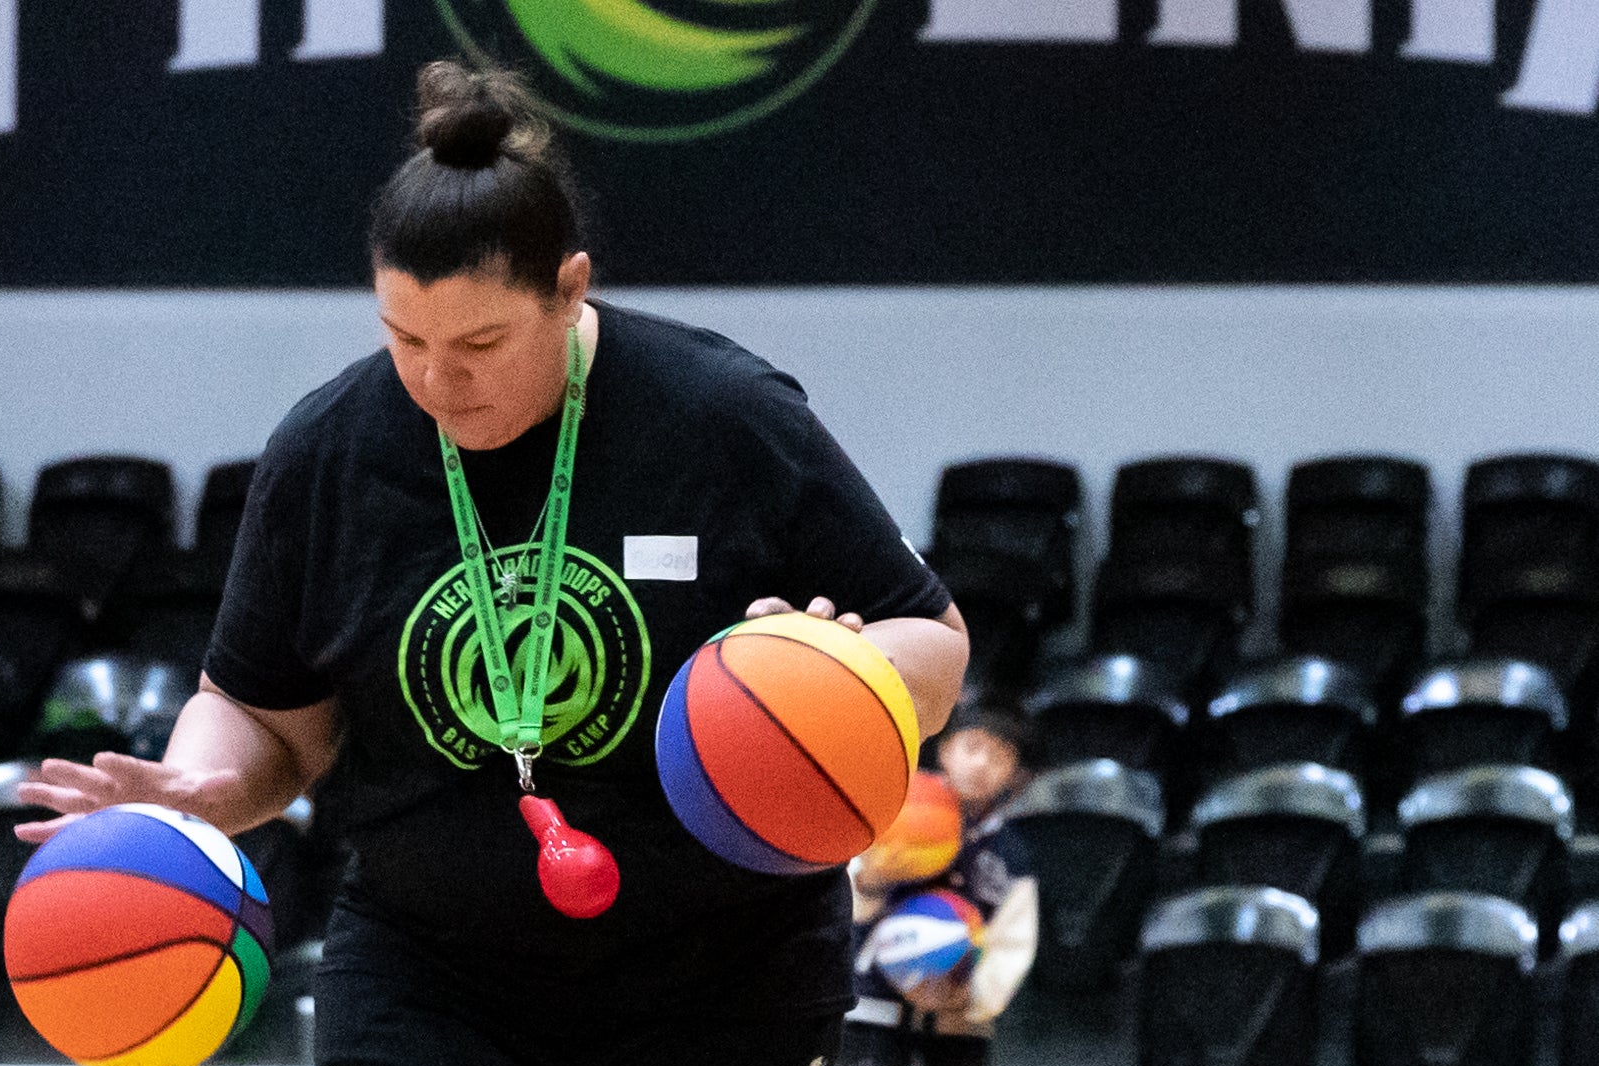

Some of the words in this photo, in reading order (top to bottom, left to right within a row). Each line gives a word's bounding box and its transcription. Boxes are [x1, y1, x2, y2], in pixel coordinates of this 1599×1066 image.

[431, 553, 543, 620] HEALAND
[561, 562, 612, 608] OOPS
[566, 714, 610, 757] CAMP
